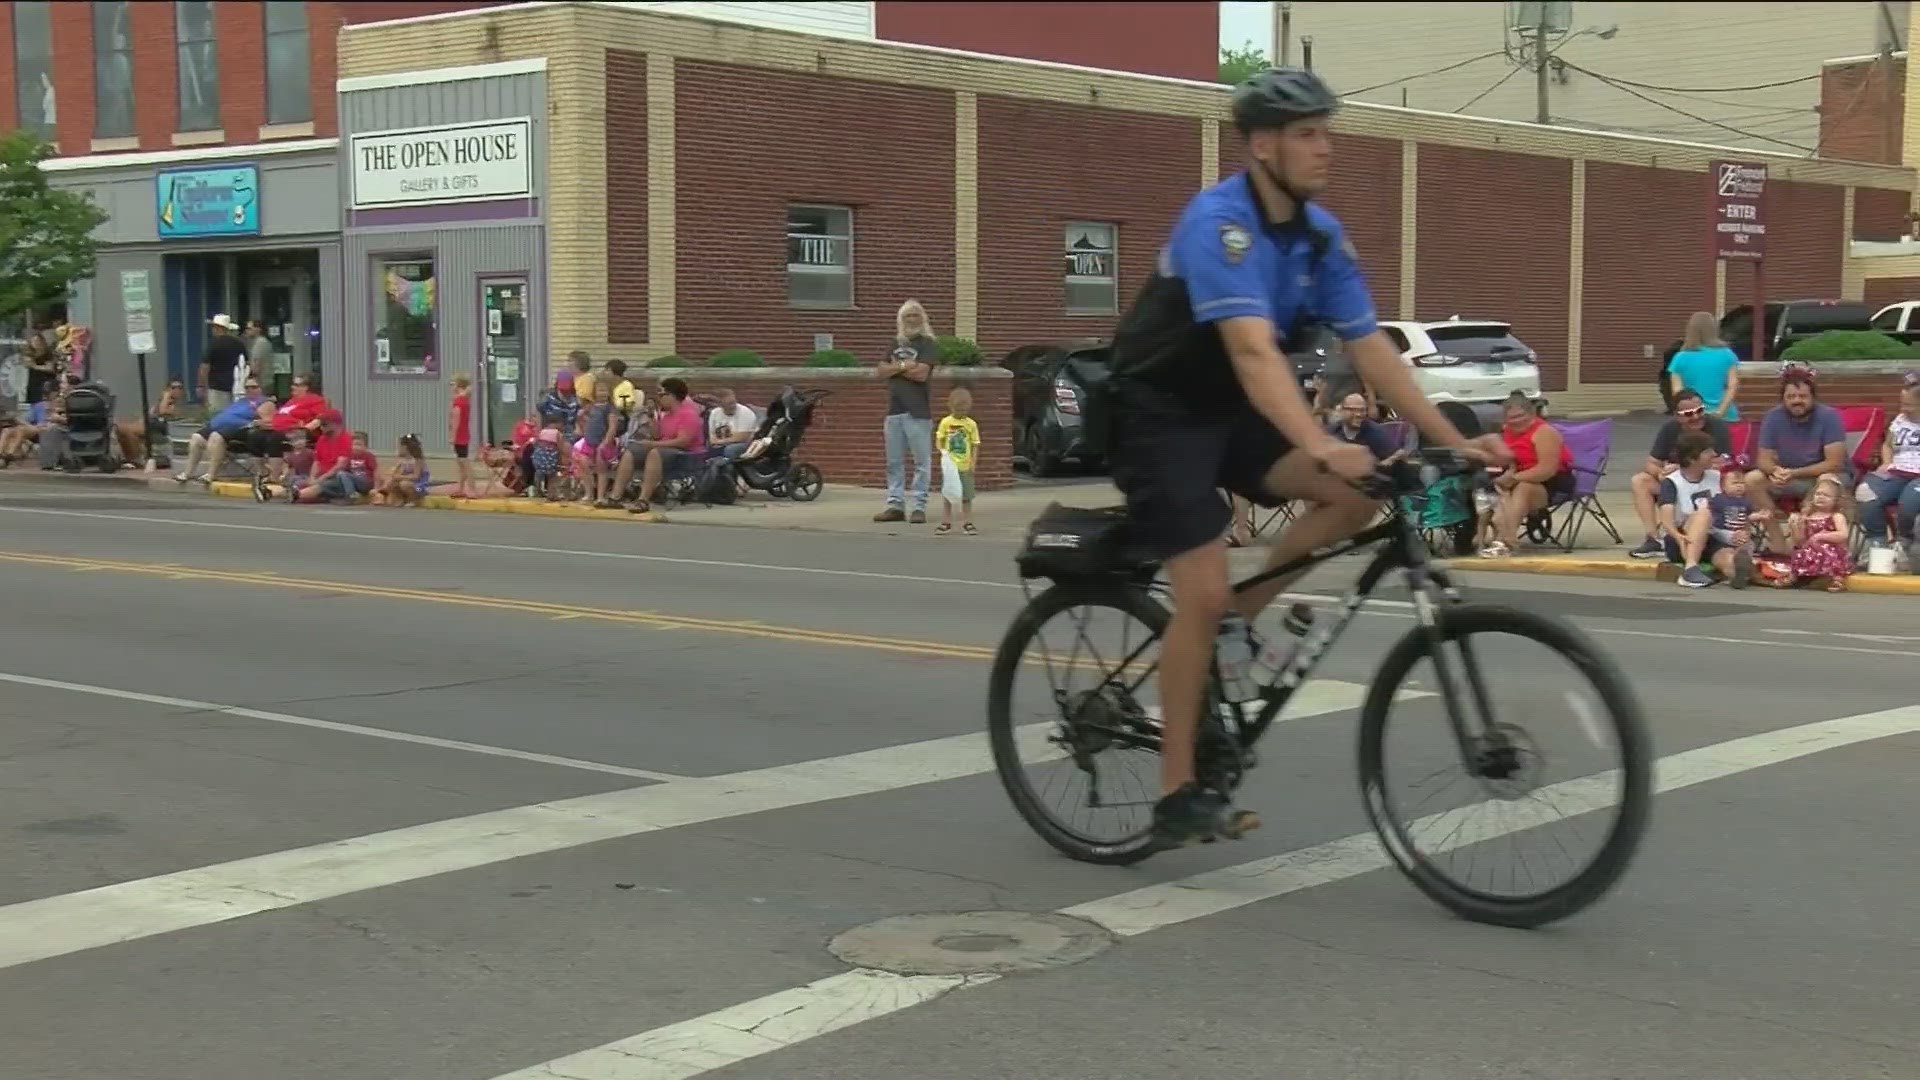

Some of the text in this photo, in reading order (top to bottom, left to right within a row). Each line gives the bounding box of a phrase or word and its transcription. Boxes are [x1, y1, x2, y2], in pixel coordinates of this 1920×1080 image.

[361, 133, 518, 171] THE OPEN HOUSE
[401, 175, 479, 192] GALLERY & GIFTS
[1726, 203, 1756, 219] ENTER
[800, 239, 836, 265] THE
[1074, 253, 1104, 275] OPEN
